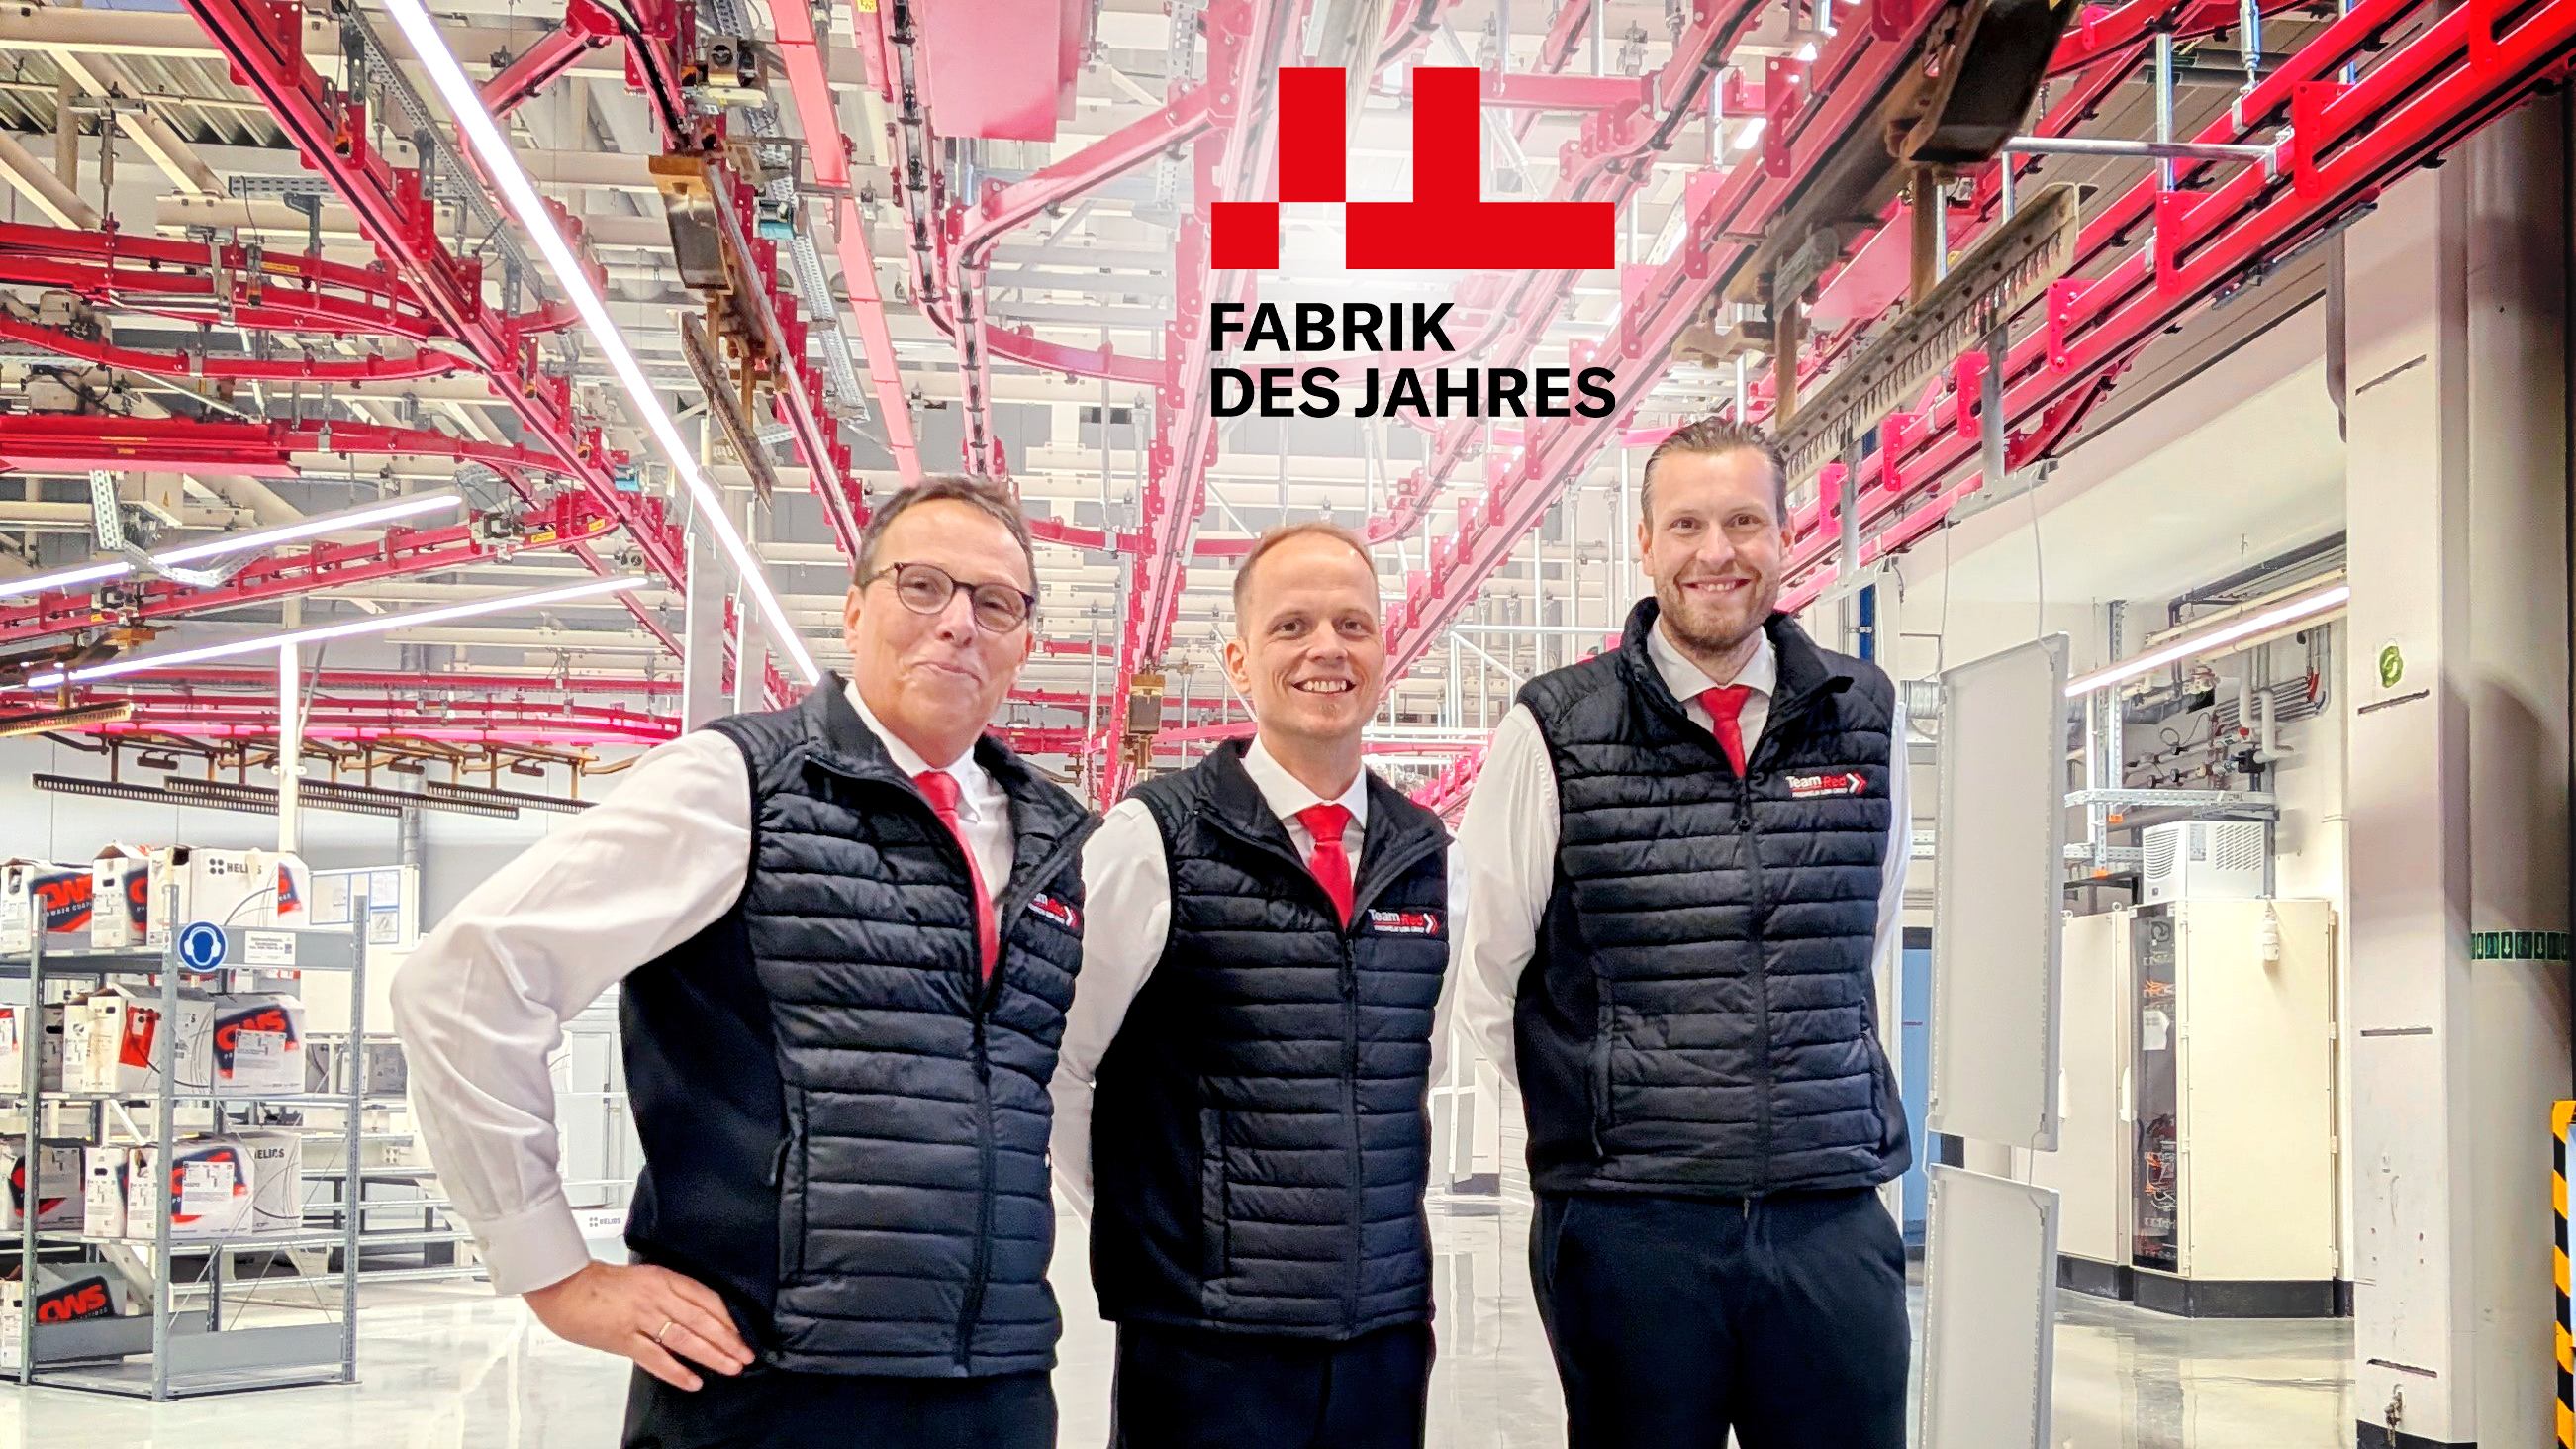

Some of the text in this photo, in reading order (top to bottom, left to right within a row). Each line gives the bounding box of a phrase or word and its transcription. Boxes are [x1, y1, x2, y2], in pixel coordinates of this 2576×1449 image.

[1785, 776, 1847, 788] Team Red
[226, 862, 262, 875] HELIS
[1368, 909, 1400, 922] Team
[254, 1148, 285, 1159] ELIOS
[38, 1284, 106, 1323] CWS
